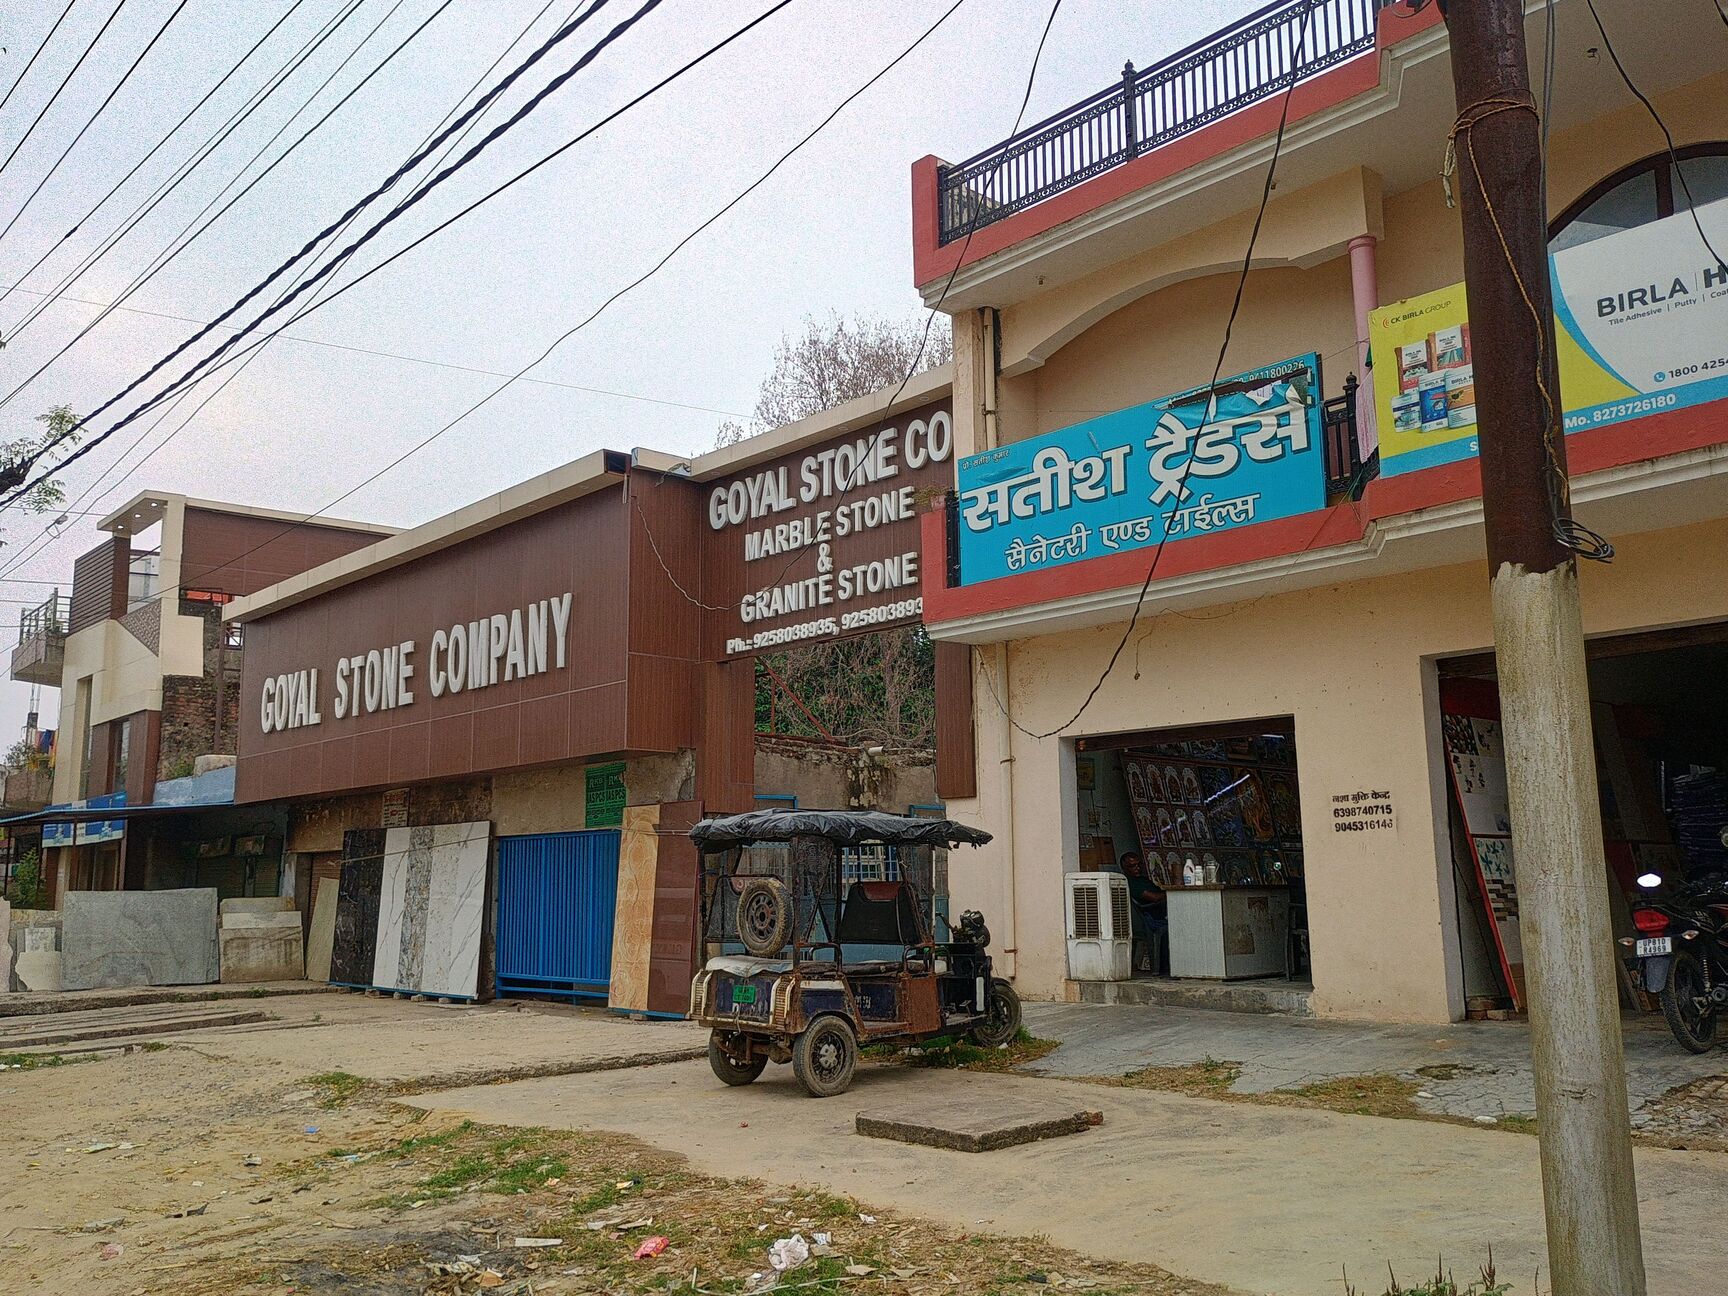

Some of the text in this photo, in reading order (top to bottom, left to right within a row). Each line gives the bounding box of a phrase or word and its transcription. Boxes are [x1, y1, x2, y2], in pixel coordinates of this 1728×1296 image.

[1391, 300, 1451, 324] CK BIRLA GROUP
[1597, 277, 1689, 318] BIRLA
[1608, 318, 1624, 326] Tile
[1625, 307, 1662, 322] Adhesive
[1675, 298, 1697, 309] Putty
[1668, 364, 1698, 378] 1800
[1565, 393, 1676, 429] Mo. 8273726180
[709, 411, 952, 530] GOYAL STONE CO
[961, 444, 1132, 533] सतीश
[745, 486, 915, 562] MARBLE STONE
[1004, 493, 1261, 570] सैनेटरी एण्ड टाईल्स
[817, 542, 833, 573] &
[741, 552, 918, 623] GRANITE STONE
[261, 592, 572, 733] GOYAL STONE COMPANY
[1333, 804, 1392, 818] 6398740715
